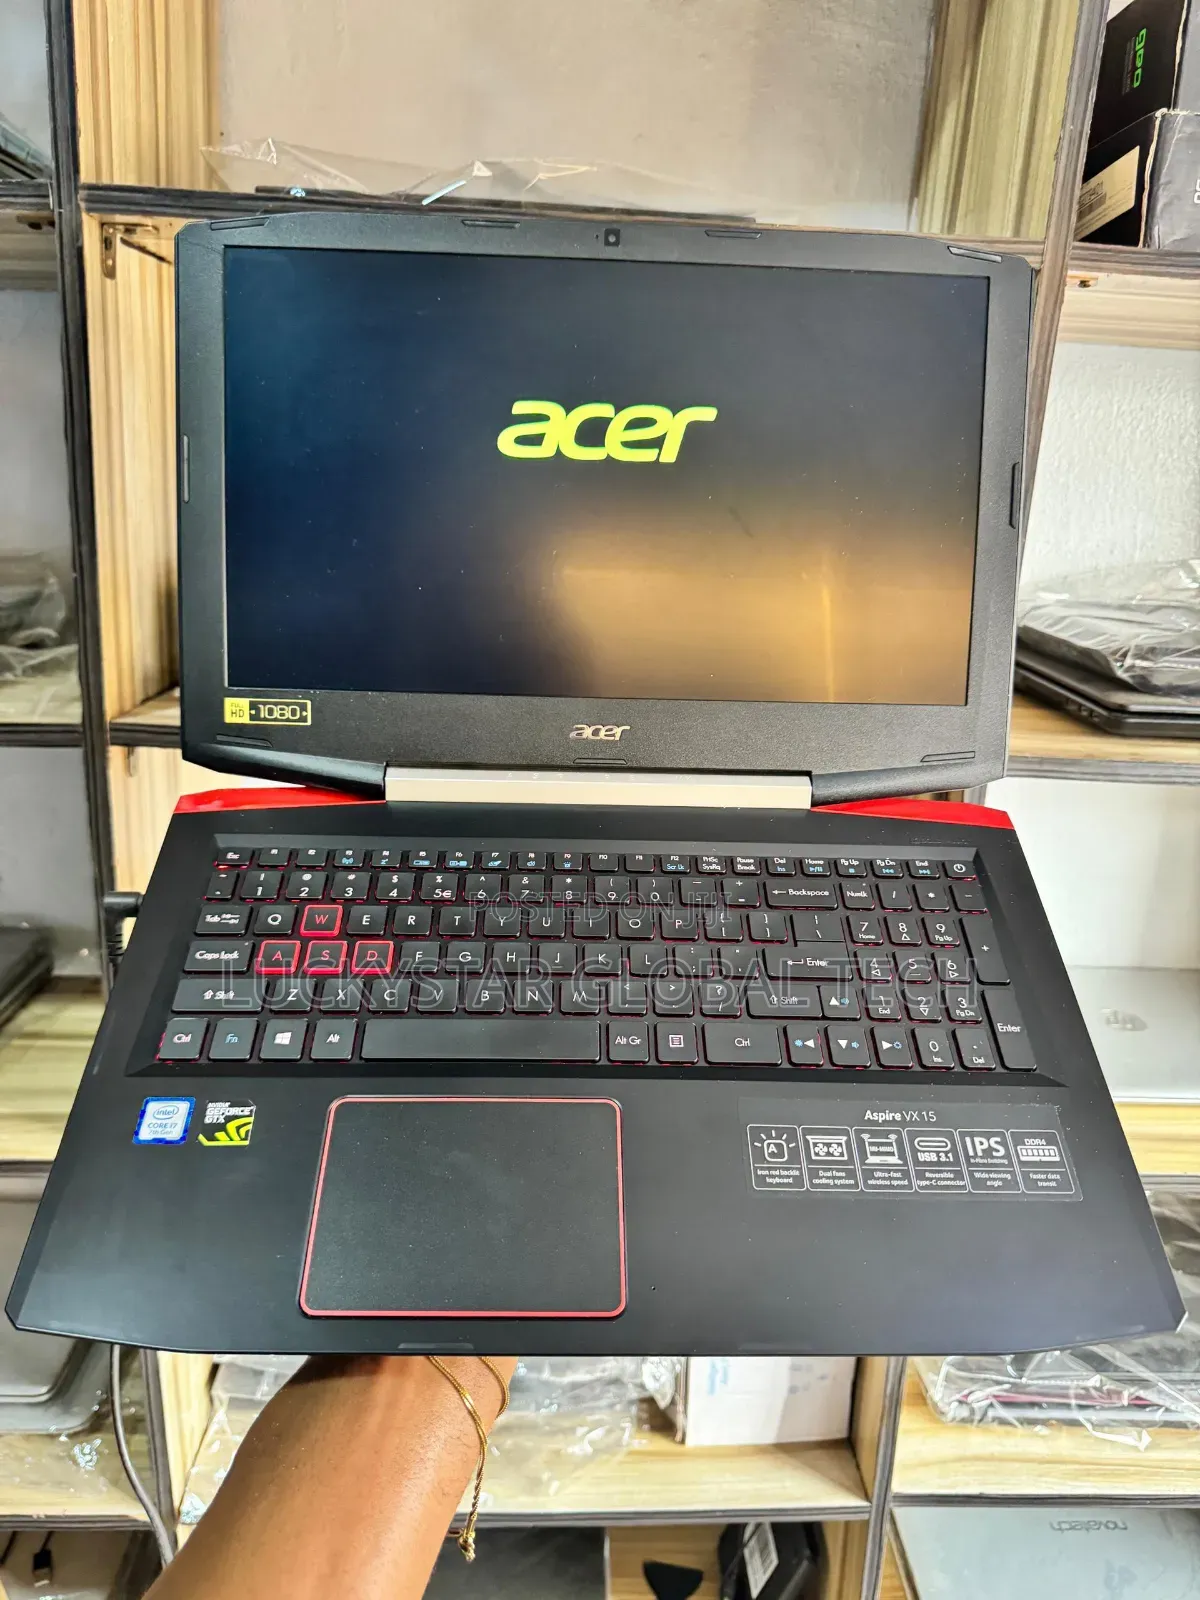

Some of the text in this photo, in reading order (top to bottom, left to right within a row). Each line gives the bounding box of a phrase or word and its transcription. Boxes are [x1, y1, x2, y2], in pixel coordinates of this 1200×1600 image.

[497, 400, 718, 463] acer
[231, 709, 244, 718] HD
[258, 705, 300, 719] 1080
[569, 724, 631, 740] acer
[702, 863, 720, 871] SysRq
[391, 874, 399, 883] $
[257, 886, 262, 896] 1
[299, 887, 310, 896] 2
[344, 887, 353, 896] 3
[388, 888, 398, 897] 4
[477, 889, 487, 899] 6
[521, 890, 530, 899] 7
[565, 890, 573, 899] 8
[607, 891, 616, 900] 9
[788, 889, 829, 897] Backspace
[205, 914, 220, 922] Tab
[267, 914, 281, 925] Q
[315, 914, 328, 924] W
[362, 915, 371, 925] E
[407, 915, 416, 925] R
[454, 916, 461, 926] T
[499, 916, 506, 927] Y
[542, 917, 551, 927] U
[629, 918, 641, 928] O
[675, 920, 682, 929] P
[860, 922, 869, 932] 7
[898, 923, 907, 933] 8
[936, 923, 946, 933] 9
[195, 950, 240, 960] Caps Lock
[272, 950, 283, 961] A
[321, 950, 330, 961] S
[367, 950, 378, 961] D
[415, 951, 423, 962] F
[459, 952, 472, 962] G
[506, 952, 516, 962] H
[555, 953, 560, 963] J
[598, 954, 607, 964] K
[645, 954, 651, 965] L
[806, 957, 828, 967] Enter
[870, 958, 878, 968] 4
[909, 959, 917, 969] 5
[947, 960, 957, 970] 6
[287, 989, 299, 1000] Z
[336, 989, 347, 1000] X
[384, 989, 396, 1000] C
[434, 990, 442, 1000] V
[715, 985, 723, 995] ?
[481, 990, 489, 1001] B
[527, 990, 538, 1001] N
[573, 990, 587, 1002] M
[780, 996, 798, 1005] Shift
[879, 996, 885, 1006] 1
[917, 997, 928, 1007] 2
[957, 997, 967, 1008] 3
[997, 1023, 1021, 1032] Enter
[173, 1033, 192, 1043] Ctrl
[225, 1033, 239, 1043] Fn
[326, 1033, 340, 1043] Alt
[615, 1036, 641, 1045] Alt Gr
[734, 1038, 750, 1046] Ctrl
[929, 1041, 939, 1051] 0
[156, 1108, 175, 1116] intel
[206, 1106, 251, 1116] GEFORCE
[864, 1110, 937, 1122] Aspire VX 15
[204, 1115, 225, 1124] GTX
[768, 1144, 778, 1153] A
[965, 1137, 1005, 1157] IPS
[917, 1153, 953, 1162] USB 3.1
[989, 1172, 1011, 1180] viewing
[1050, 1519, 1127, 1534] novatech
